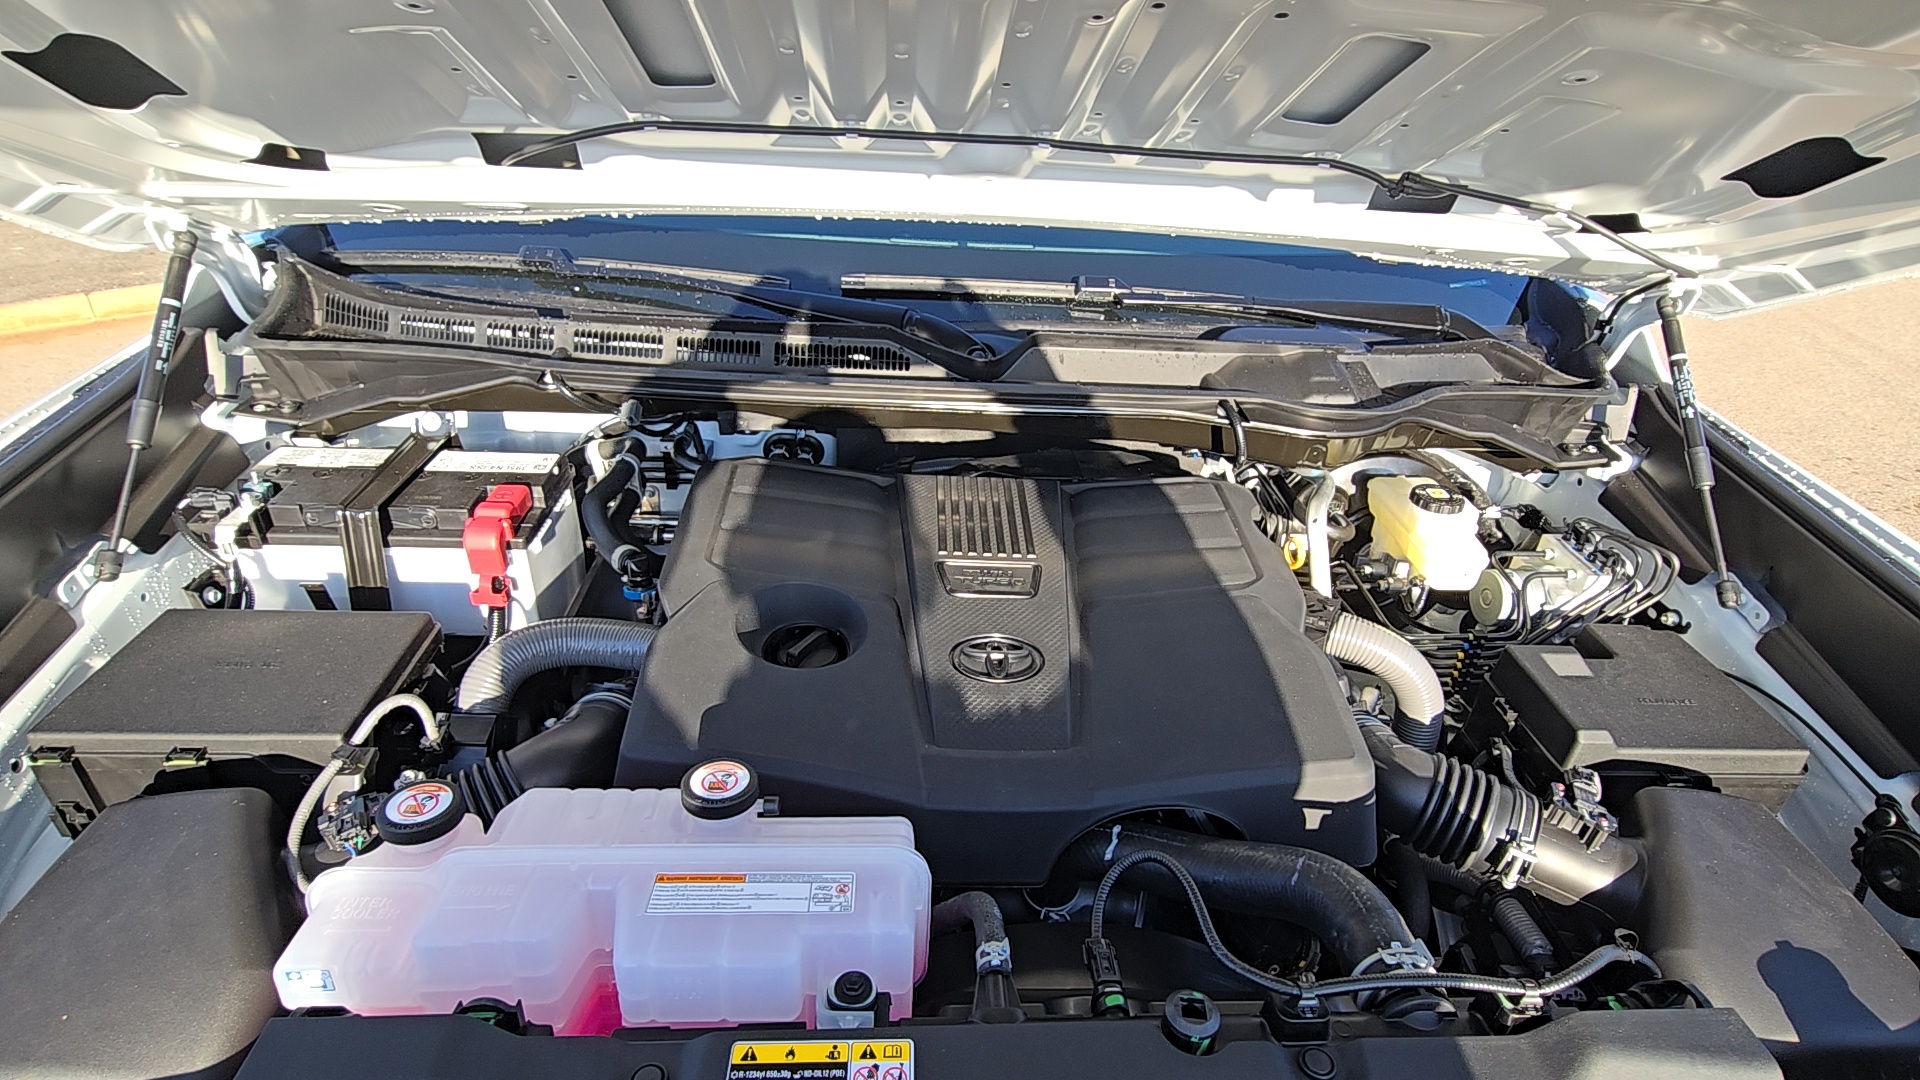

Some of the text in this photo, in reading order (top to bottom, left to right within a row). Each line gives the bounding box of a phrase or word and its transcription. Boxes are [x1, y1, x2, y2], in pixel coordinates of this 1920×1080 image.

[962, 568, 1013, 576] TWIN
[953, 575, 1026, 586] TURBO
[449, 884, 517, 898] ENGINE
[334, 896, 393, 908] INTER
[330, 907, 401, 920] COOLER
[829, 1068, 846, 1079] (POE)
